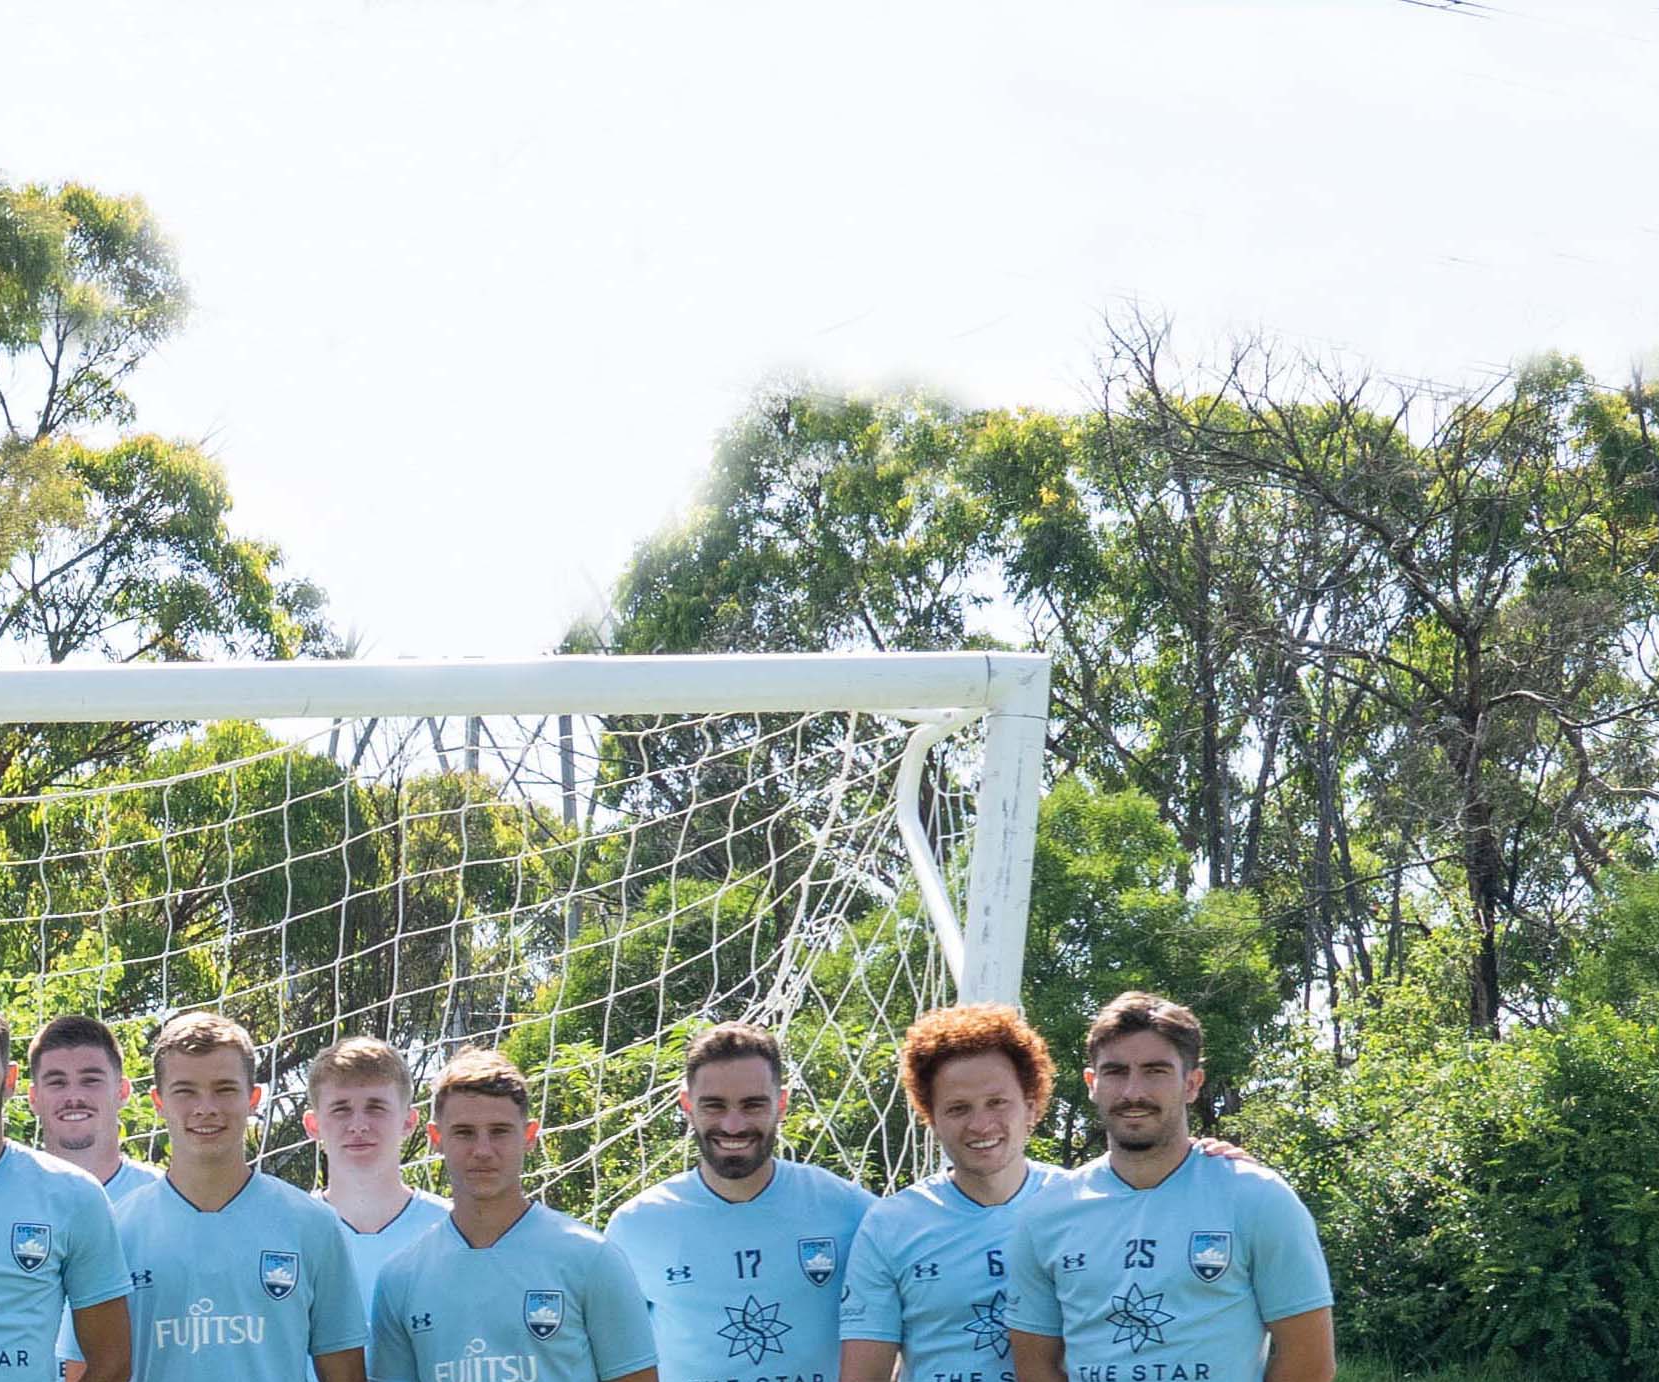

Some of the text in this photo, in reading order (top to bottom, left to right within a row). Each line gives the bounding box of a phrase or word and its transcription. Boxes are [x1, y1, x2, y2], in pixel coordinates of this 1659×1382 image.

[734, 1249, 762, 1279] 17
[987, 1249, 1004, 1277] 6
[1124, 1238, 1156, 1269] 25
[155, 1299, 266, 1355] FUJITSU
[1079, 1361, 1210, 1382] THE STAR
